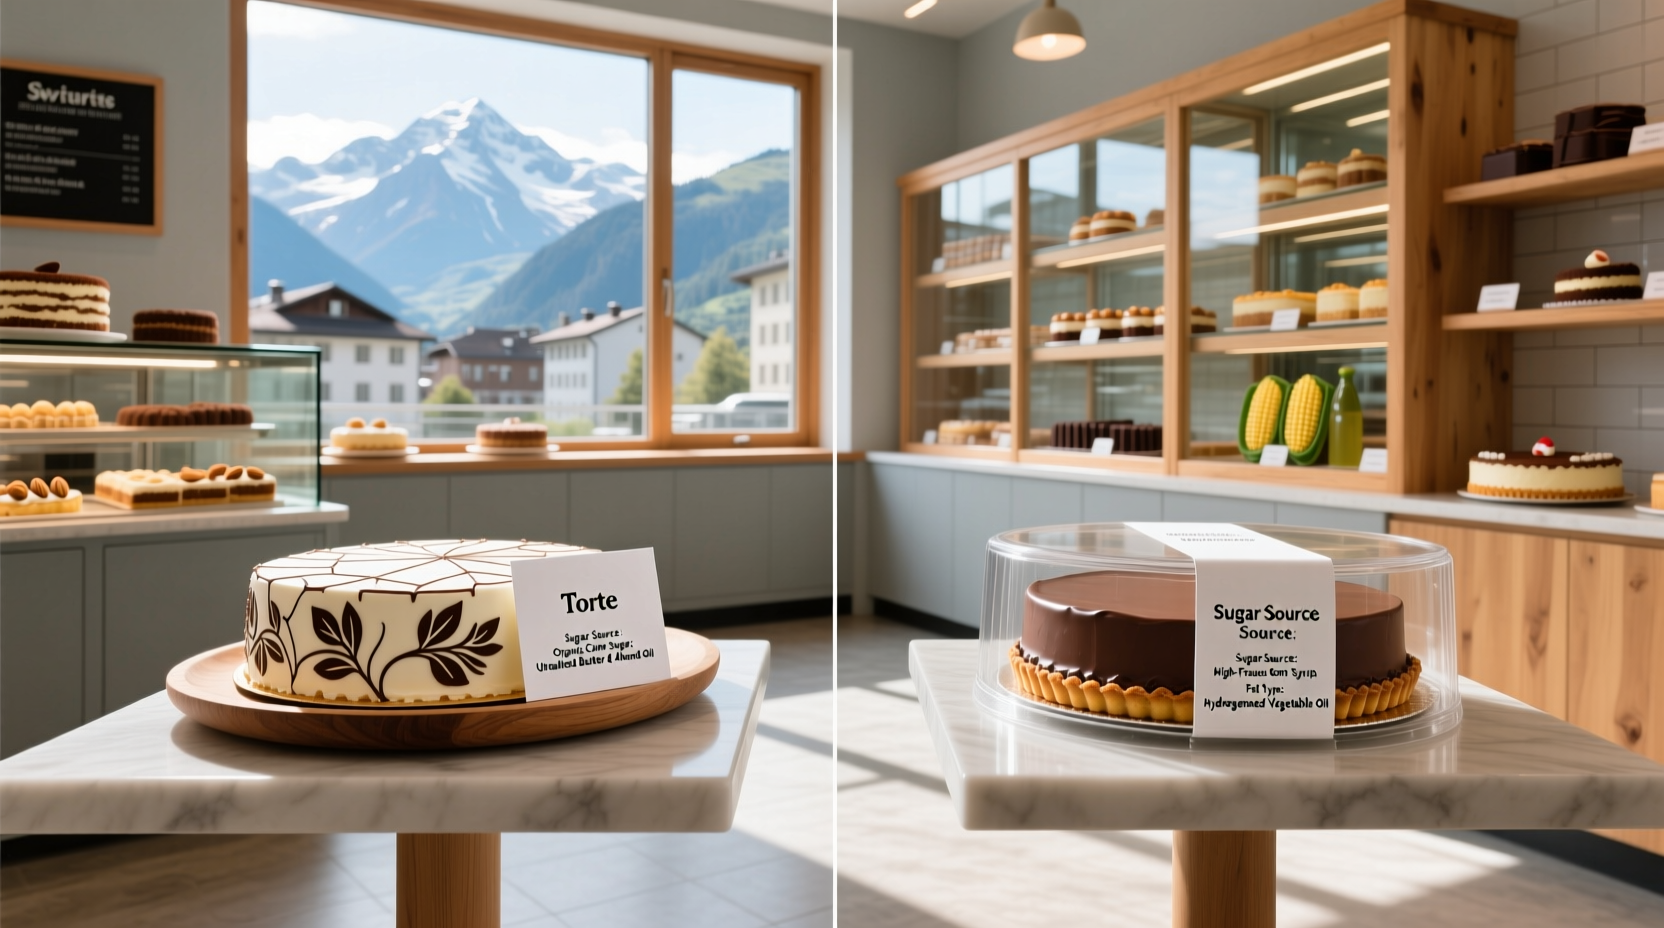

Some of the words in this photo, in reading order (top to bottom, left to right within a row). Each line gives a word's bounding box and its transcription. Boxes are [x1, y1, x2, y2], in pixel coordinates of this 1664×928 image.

[560, 591, 619, 614] Torte
[1213, 604, 1261, 624] Sugar
[1264, 604, 1321, 621] Source
[564, 633, 590, 645] Sugar
[1239, 625, 1297, 640] Source:
[642, 647, 655, 658] Oil
[1315, 698, 1329, 709] Oil
